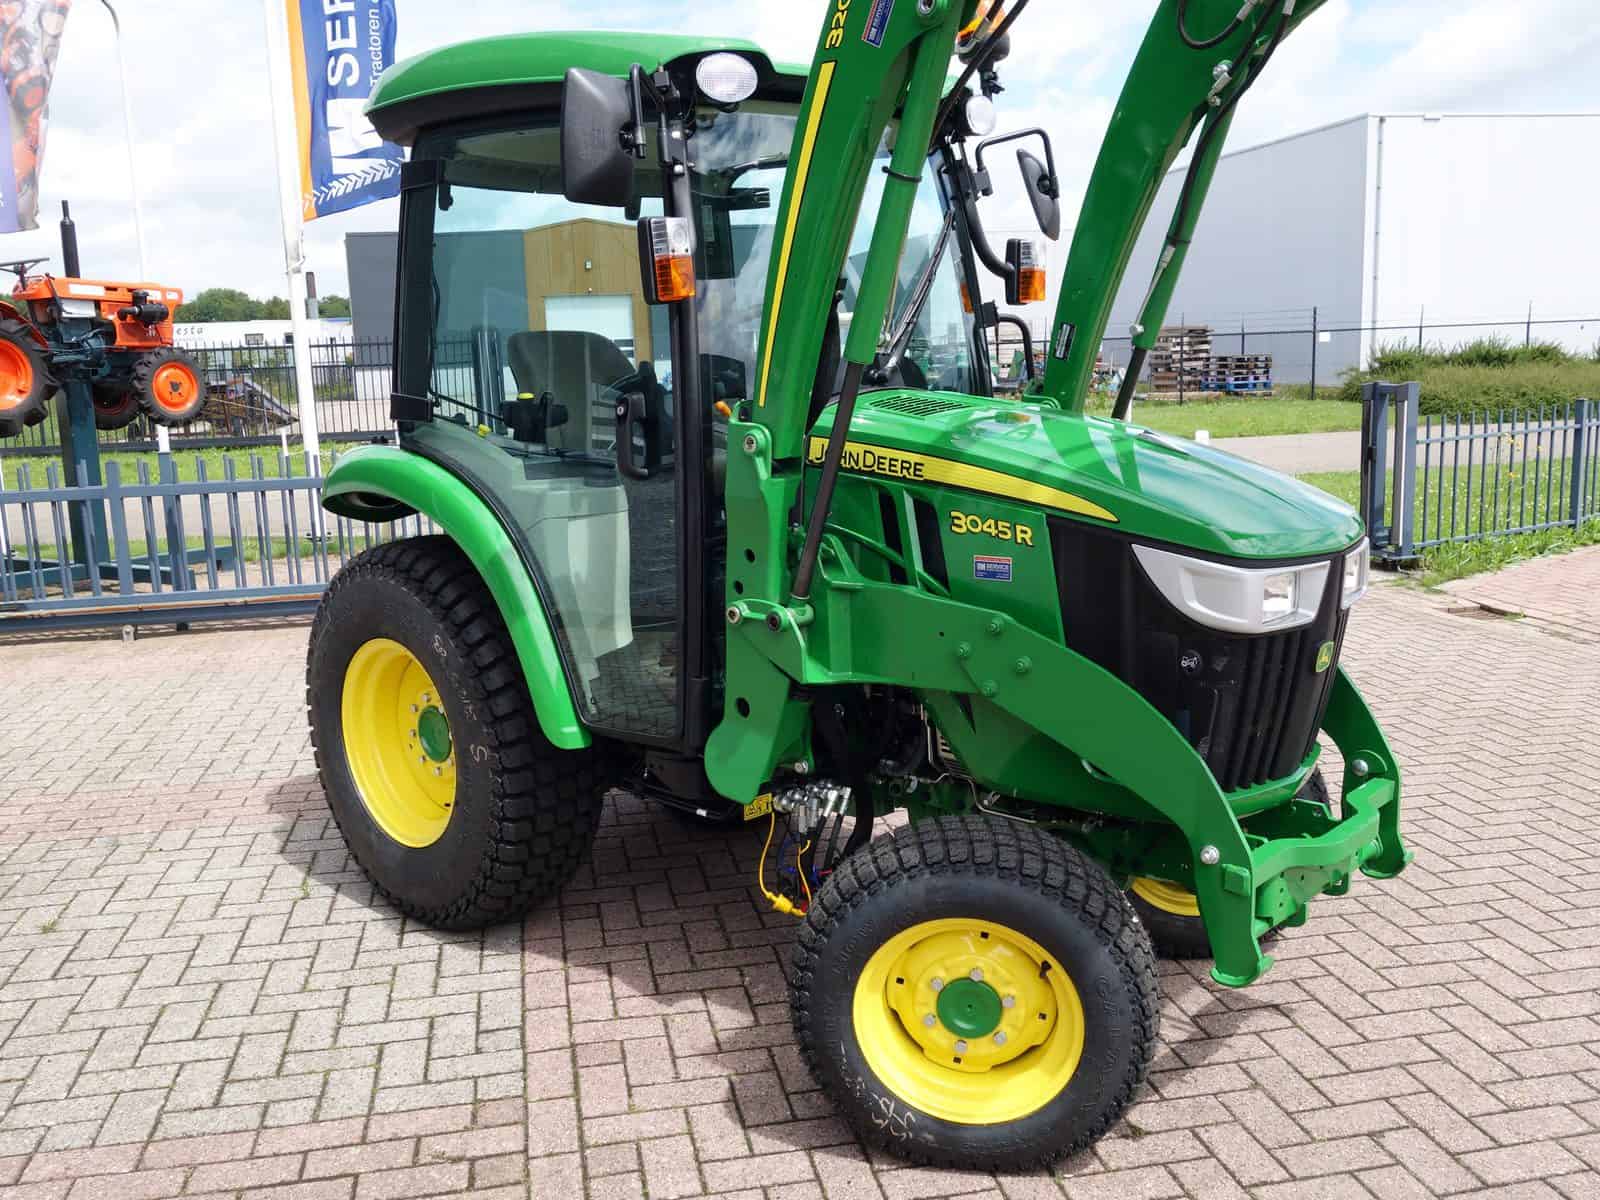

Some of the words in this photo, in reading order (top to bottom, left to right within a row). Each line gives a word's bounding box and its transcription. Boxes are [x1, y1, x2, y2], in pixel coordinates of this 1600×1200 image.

[368, 8, 383, 87] Tractoren
[815, 443, 860, 468] JHN
[863, 450, 925, 478] DEERE
